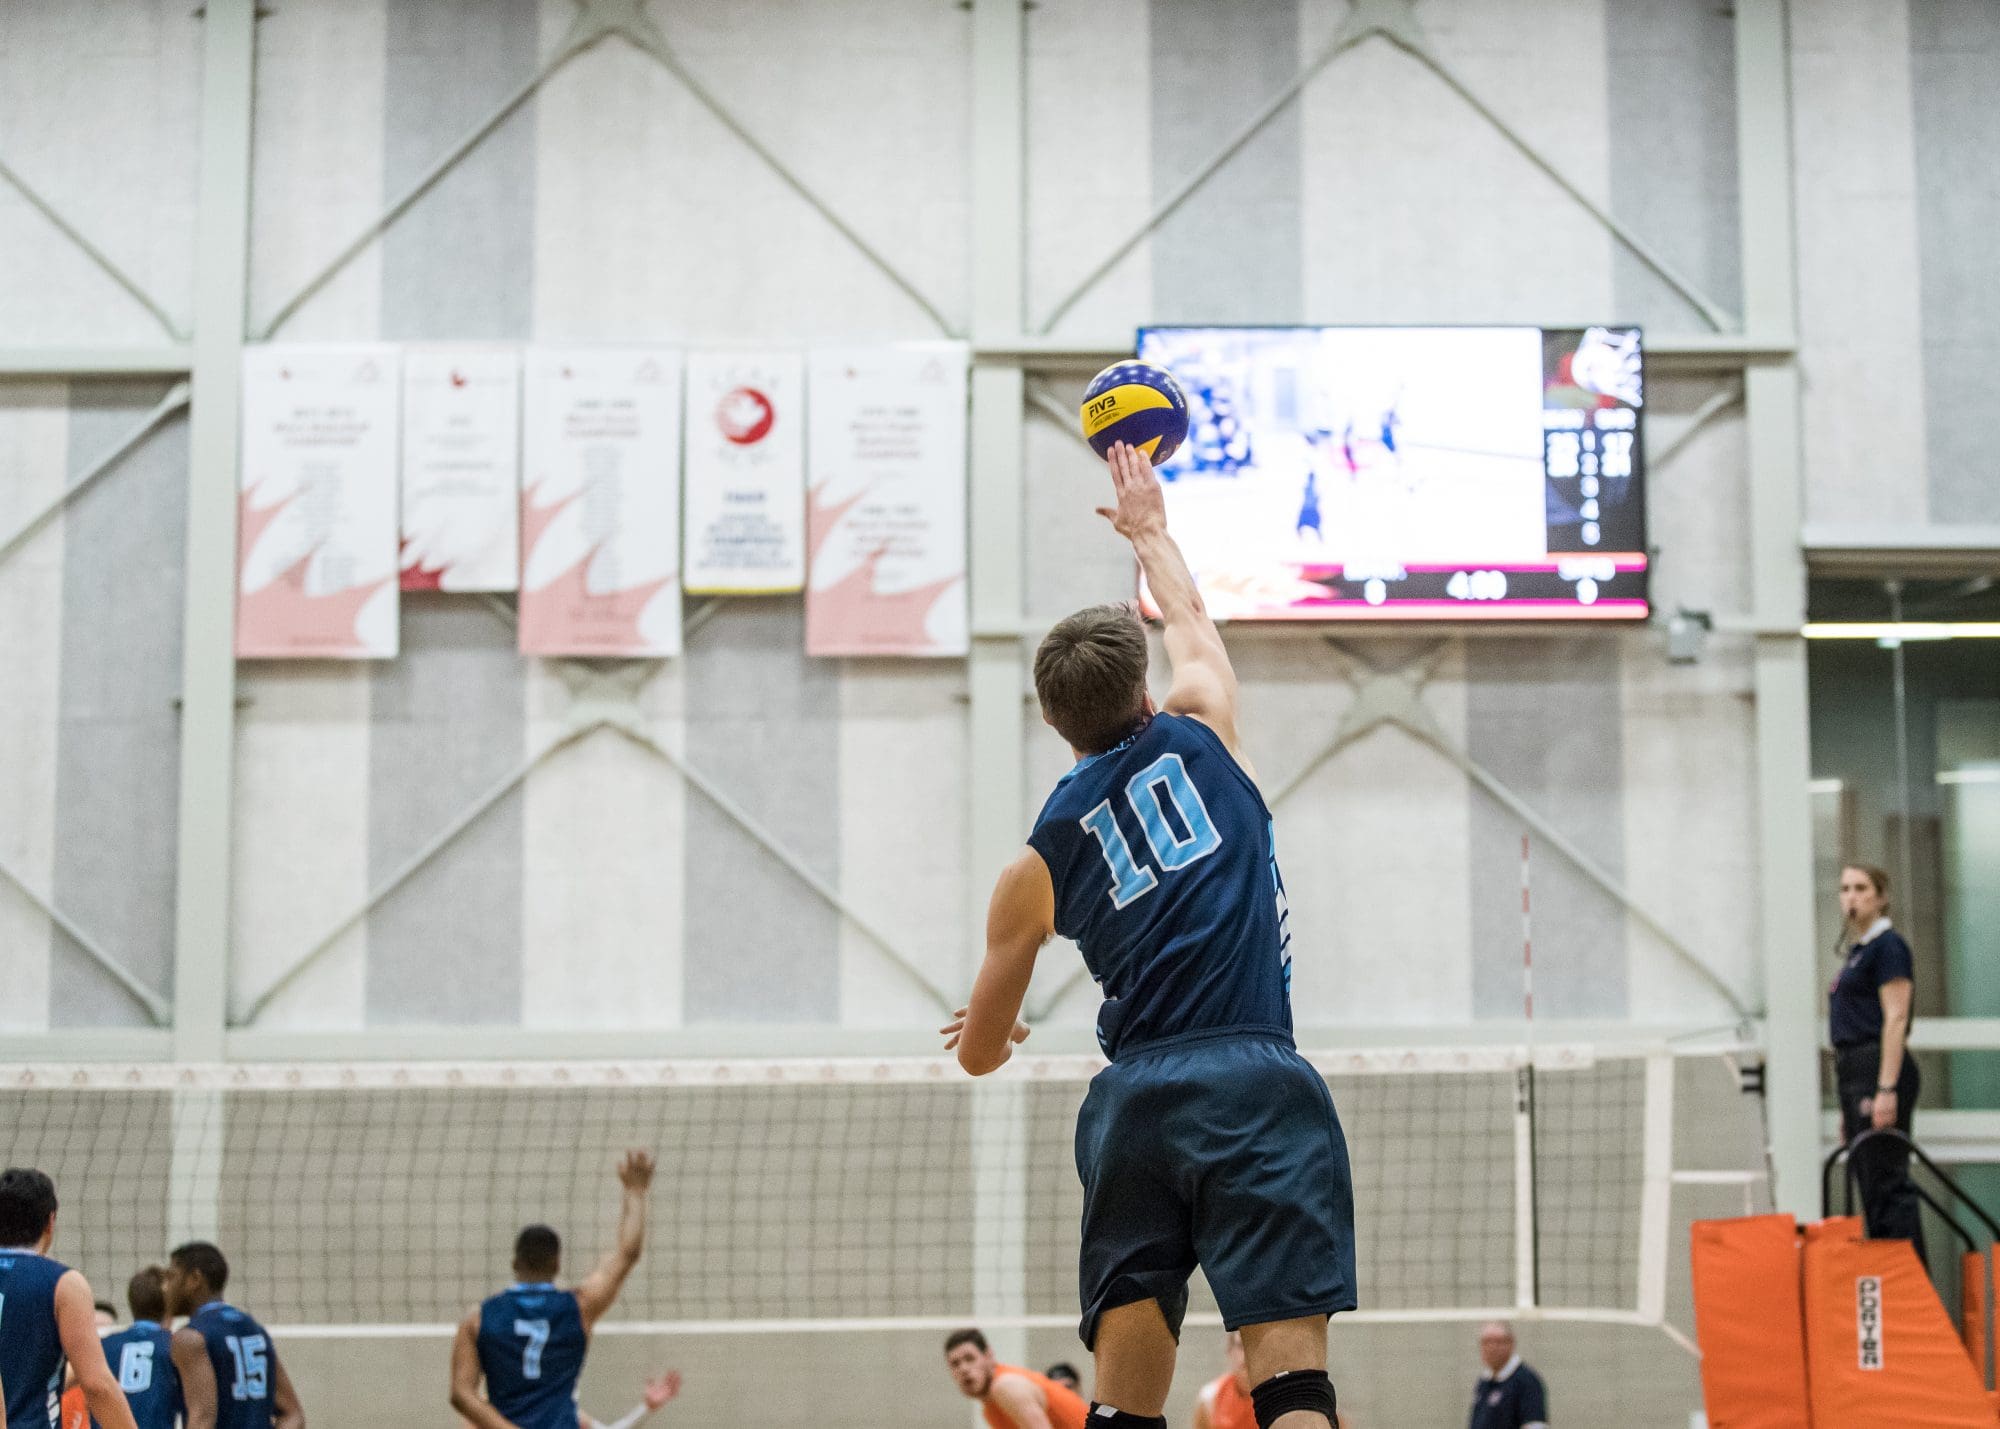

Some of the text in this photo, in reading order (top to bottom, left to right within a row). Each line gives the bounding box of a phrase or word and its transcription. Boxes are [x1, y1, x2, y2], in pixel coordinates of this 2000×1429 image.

[1079, 752, 1223, 910] 10
[513, 1317, 551, 1380] 7
[1859, 1279, 1878, 1366] PORTER
[117, 1340, 155, 1394] 6
[225, 1333, 270, 1401] 15
